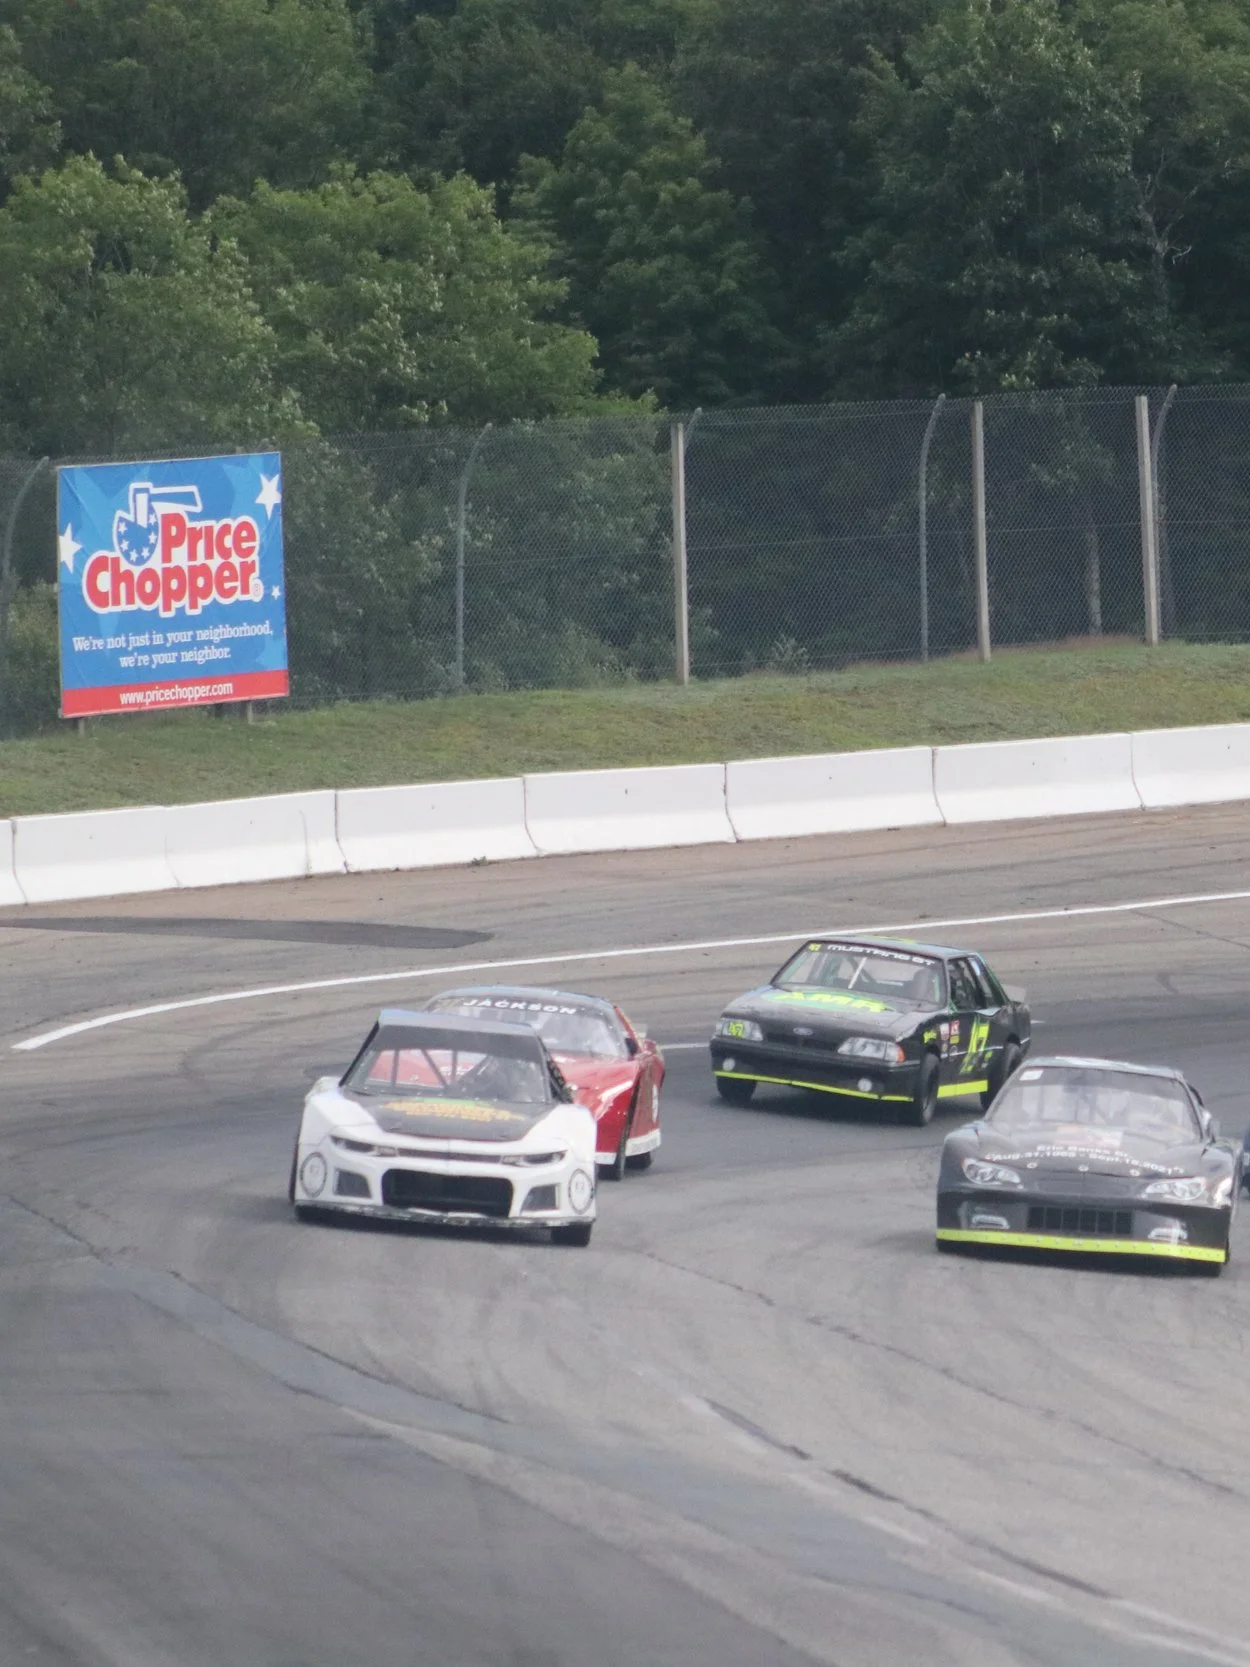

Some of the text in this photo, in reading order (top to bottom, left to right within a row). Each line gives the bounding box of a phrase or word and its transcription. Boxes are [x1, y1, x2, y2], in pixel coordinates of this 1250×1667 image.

[161, 512, 257, 564] Price
[86, 555, 256, 613] Chopper
[72, 620, 273, 652] We're not just in your neighborhood,
[119, 645, 231, 668] we're your neighbor.
[120, 682, 233, 706] www.pricechopper.com
[463, 999, 577, 1014] JACKSON
